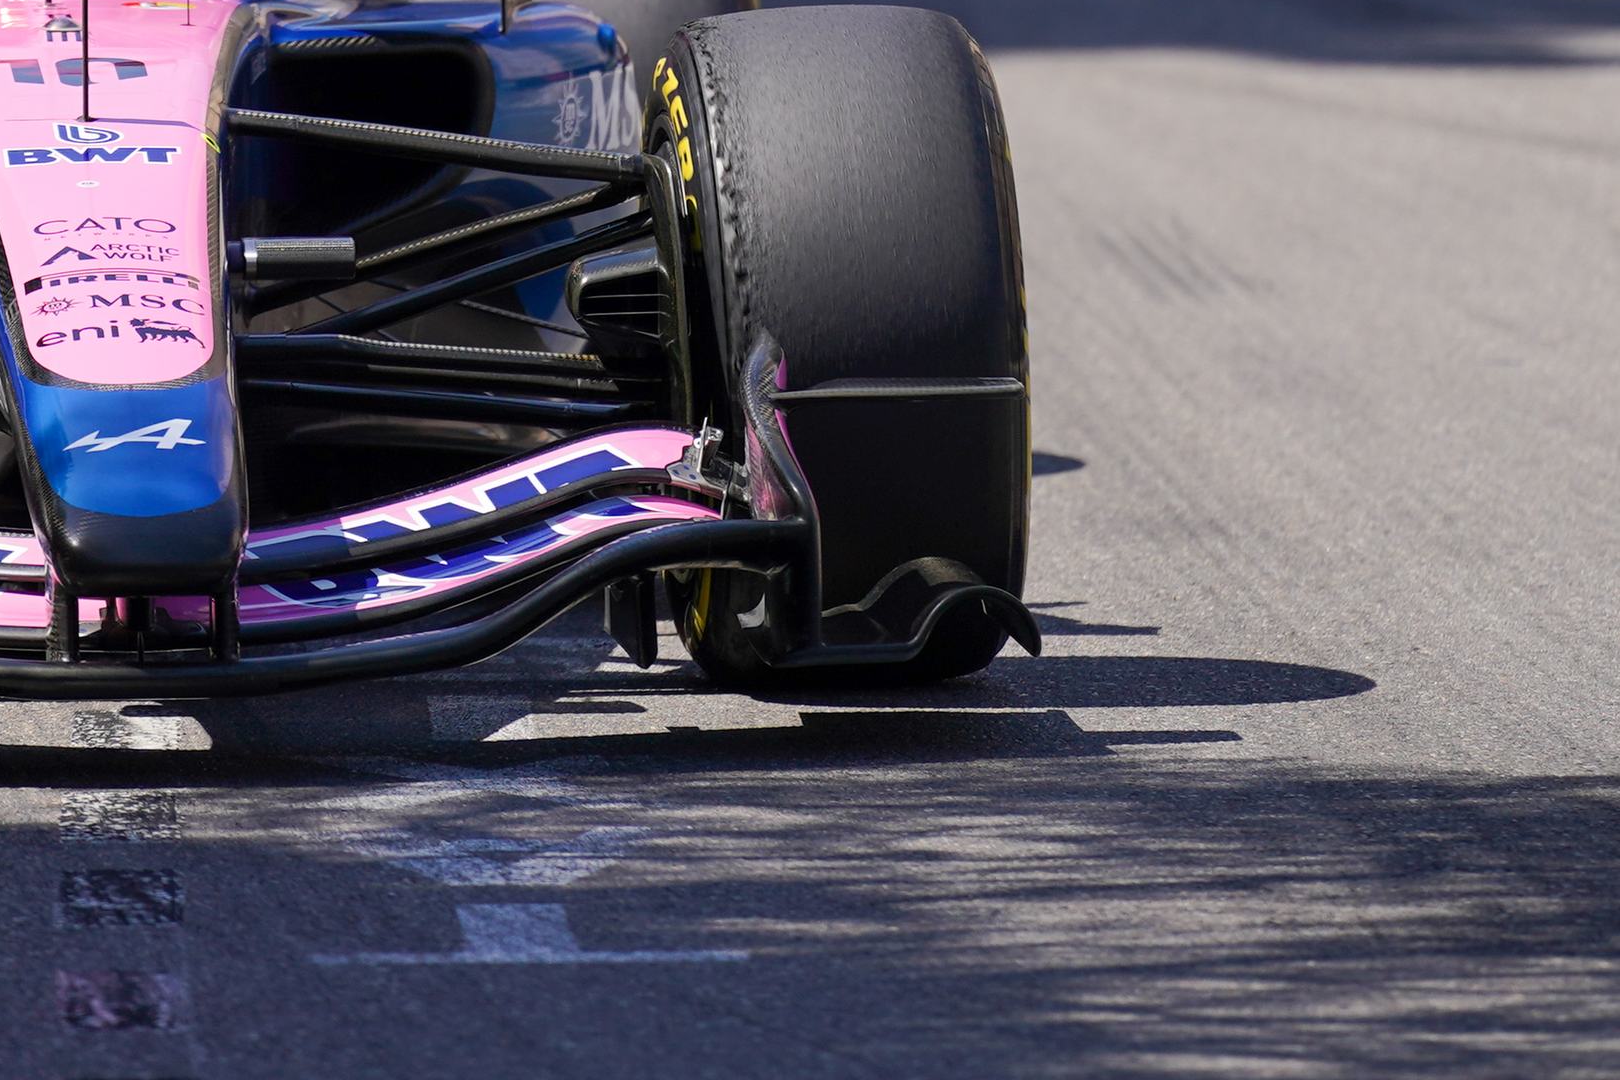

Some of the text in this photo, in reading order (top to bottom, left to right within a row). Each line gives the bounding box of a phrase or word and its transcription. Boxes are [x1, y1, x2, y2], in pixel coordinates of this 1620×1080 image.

[5, 147, 177, 166] BWT
[33, 216, 176, 235] CATO
[90, 243, 180, 256] ARCTIC
[103, 252, 173, 262] WOLF
[87, 293, 205, 316] MSC
[36, 320, 120, 348] eni
